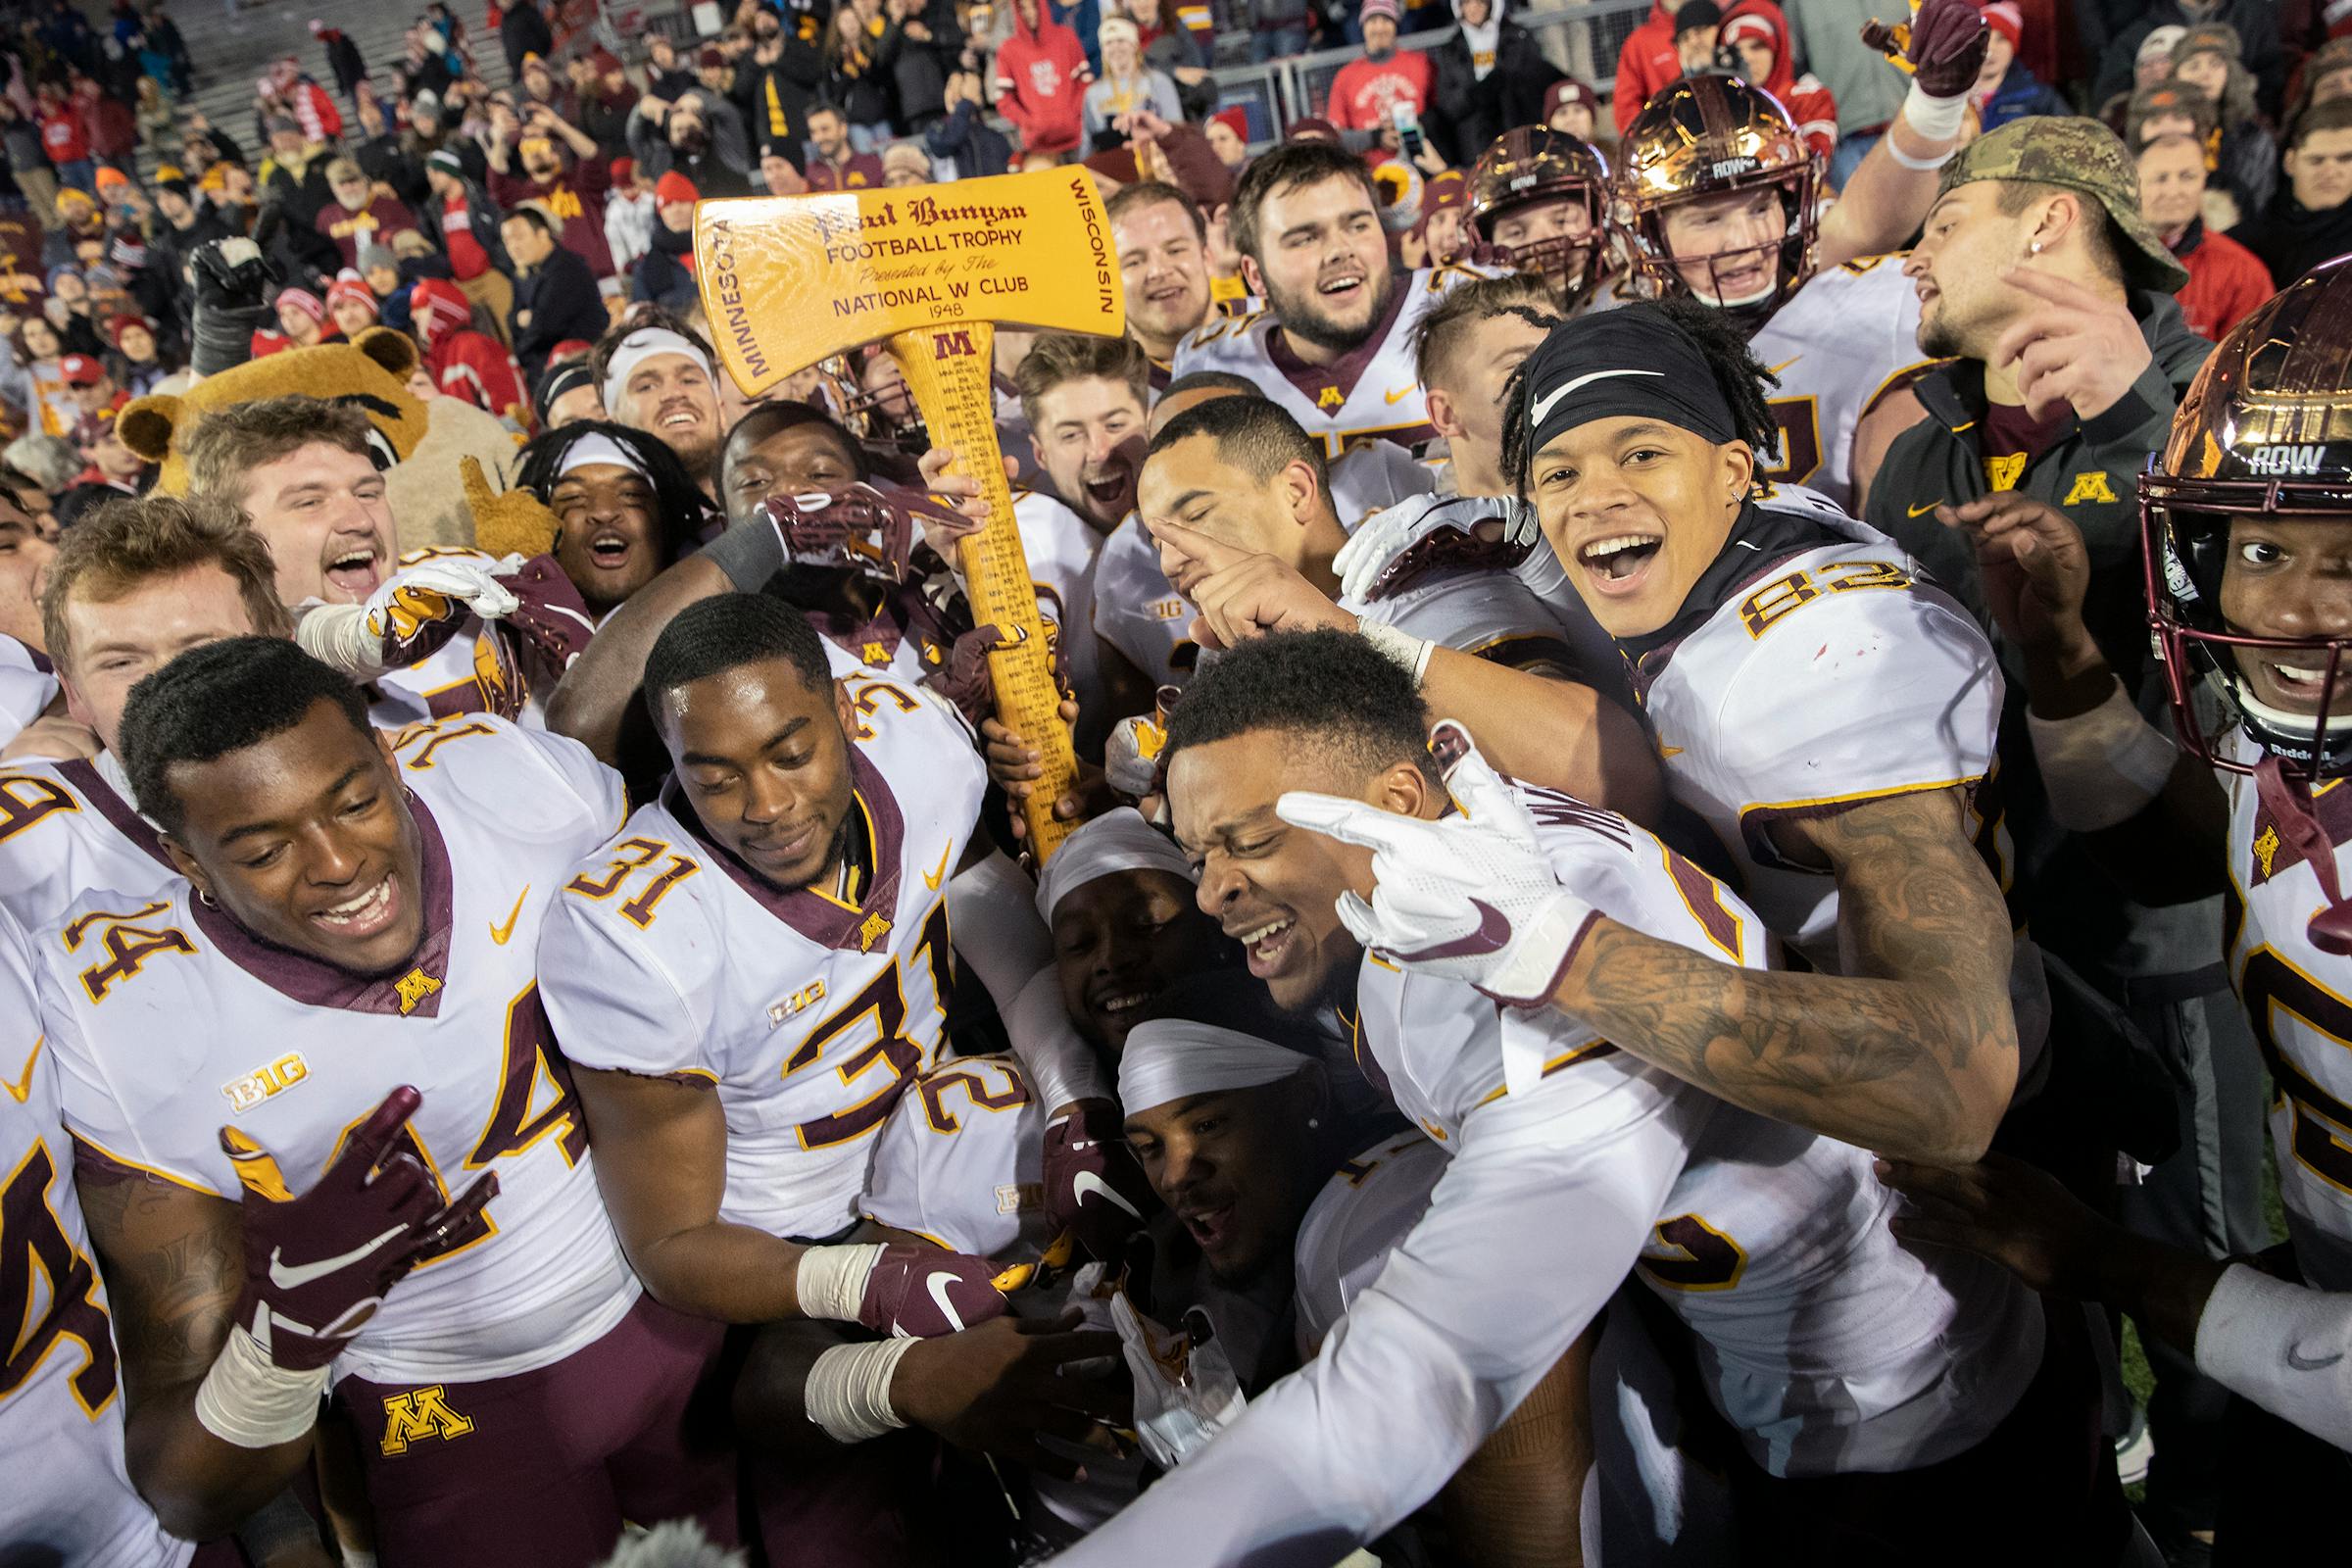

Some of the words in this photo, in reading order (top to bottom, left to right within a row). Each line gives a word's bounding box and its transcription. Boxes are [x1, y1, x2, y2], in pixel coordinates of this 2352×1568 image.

[906, 196, 1028, 227] Bunyan
[826, 234, 948, 265] FOOTBALL
[949, 229, 1022, 257] TROPHY
[1070, 178, 1114, 315] WISCONSIN
[859, 263, 931, 285] Presented
[934, 262, 956, 277] by
[962, 255, 1000, 271] The
[713, 219, 771, 379] MINNESOTA
[833, 286, 942, 318] NATIONAL
[952, 282, 970, 299] W
[979, 275, 1029, 294] CLUB
[929, 303, 964, 319] 1948
[932, 330, 977, 360] M
[1317, 386, 1347, 409] M
[2248, 445, 2327, 476] ROW
[2063, 470, 2116, 507] M
[562, 837, 701, 931] 31
[62, 900, 200, 1005] 14
[860, 910, 893, 955] M
[396, 967, 446, 1017] M
[379, 1384, 477, 1458] M
